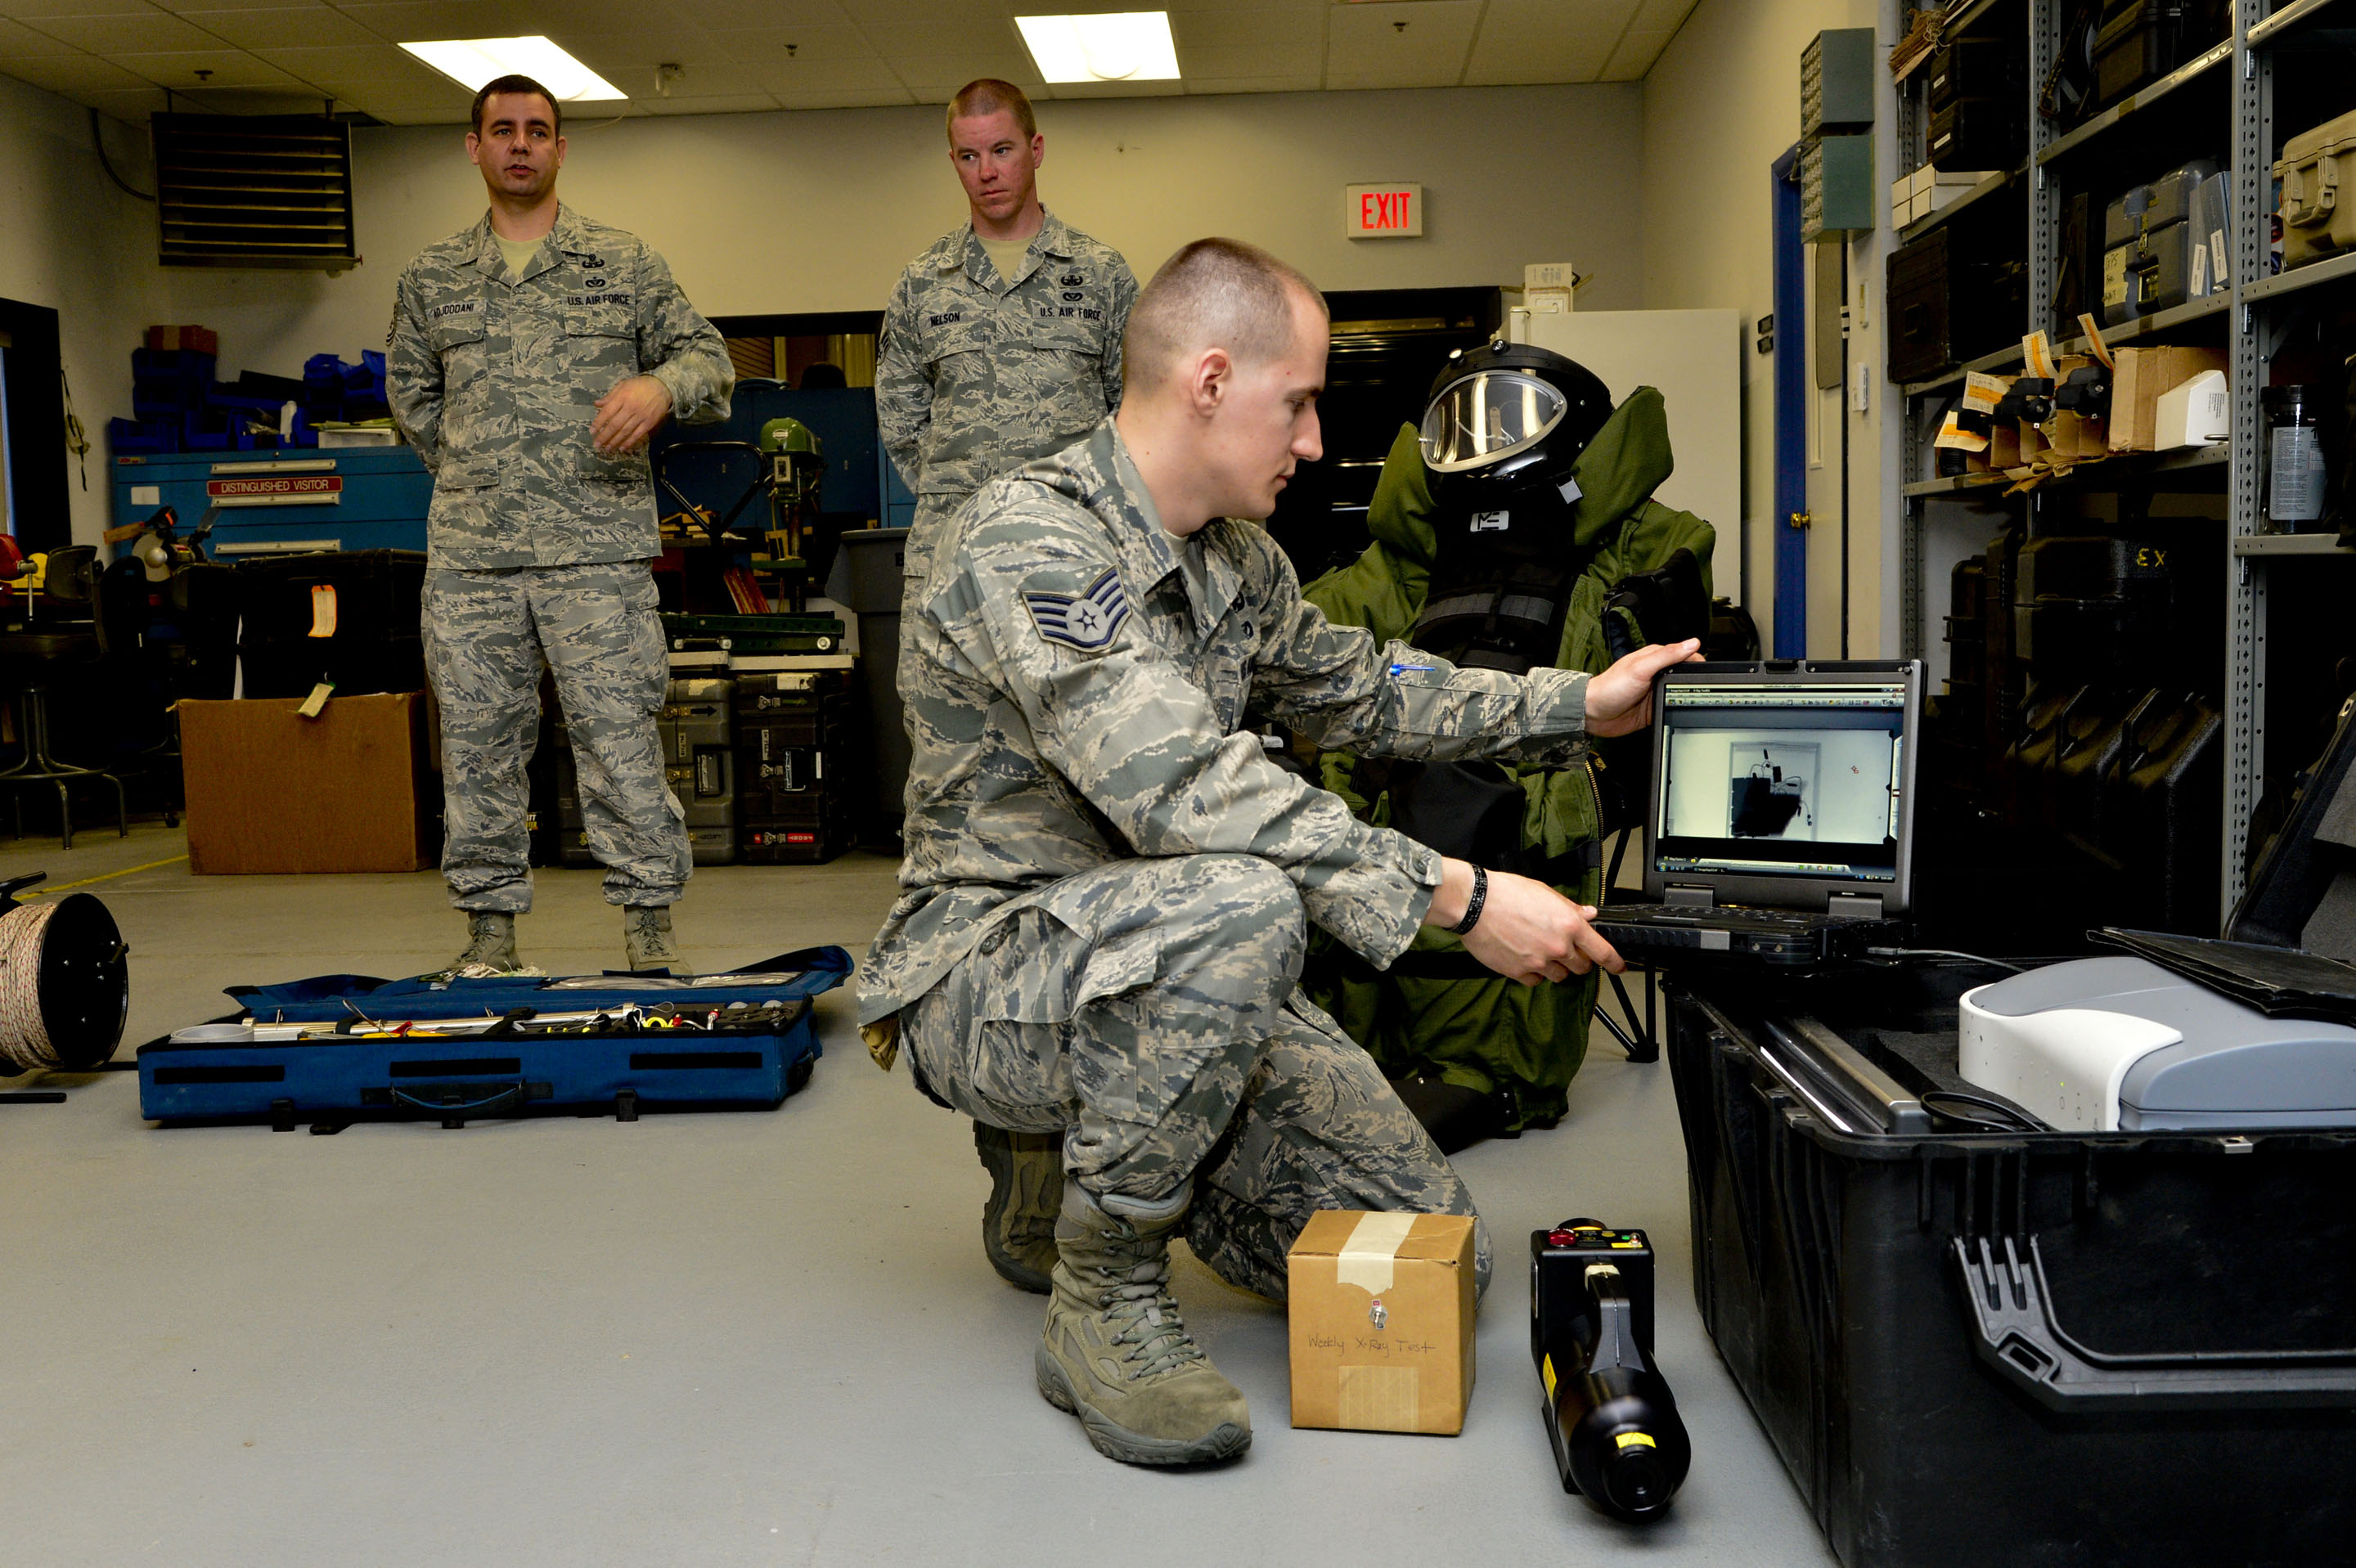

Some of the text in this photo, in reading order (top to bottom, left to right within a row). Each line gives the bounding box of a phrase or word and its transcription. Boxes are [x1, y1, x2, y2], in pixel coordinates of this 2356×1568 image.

[1361, 192, 1411, 229] EXIT
[568, 294, 630, 306] U.S. AIR FORCE
[930, 312, 960, 327] NELSON
[1040, 307, 1101, 321] U.S. AIR FORCE
[221, 479, 329, 493] DISTINGUISHED VISITOR
[2137, 548, 2166, 567] EX
[1308, 1332, 1344, 1356] Weekly
[1396, 1340, 1437, 1355] Test
